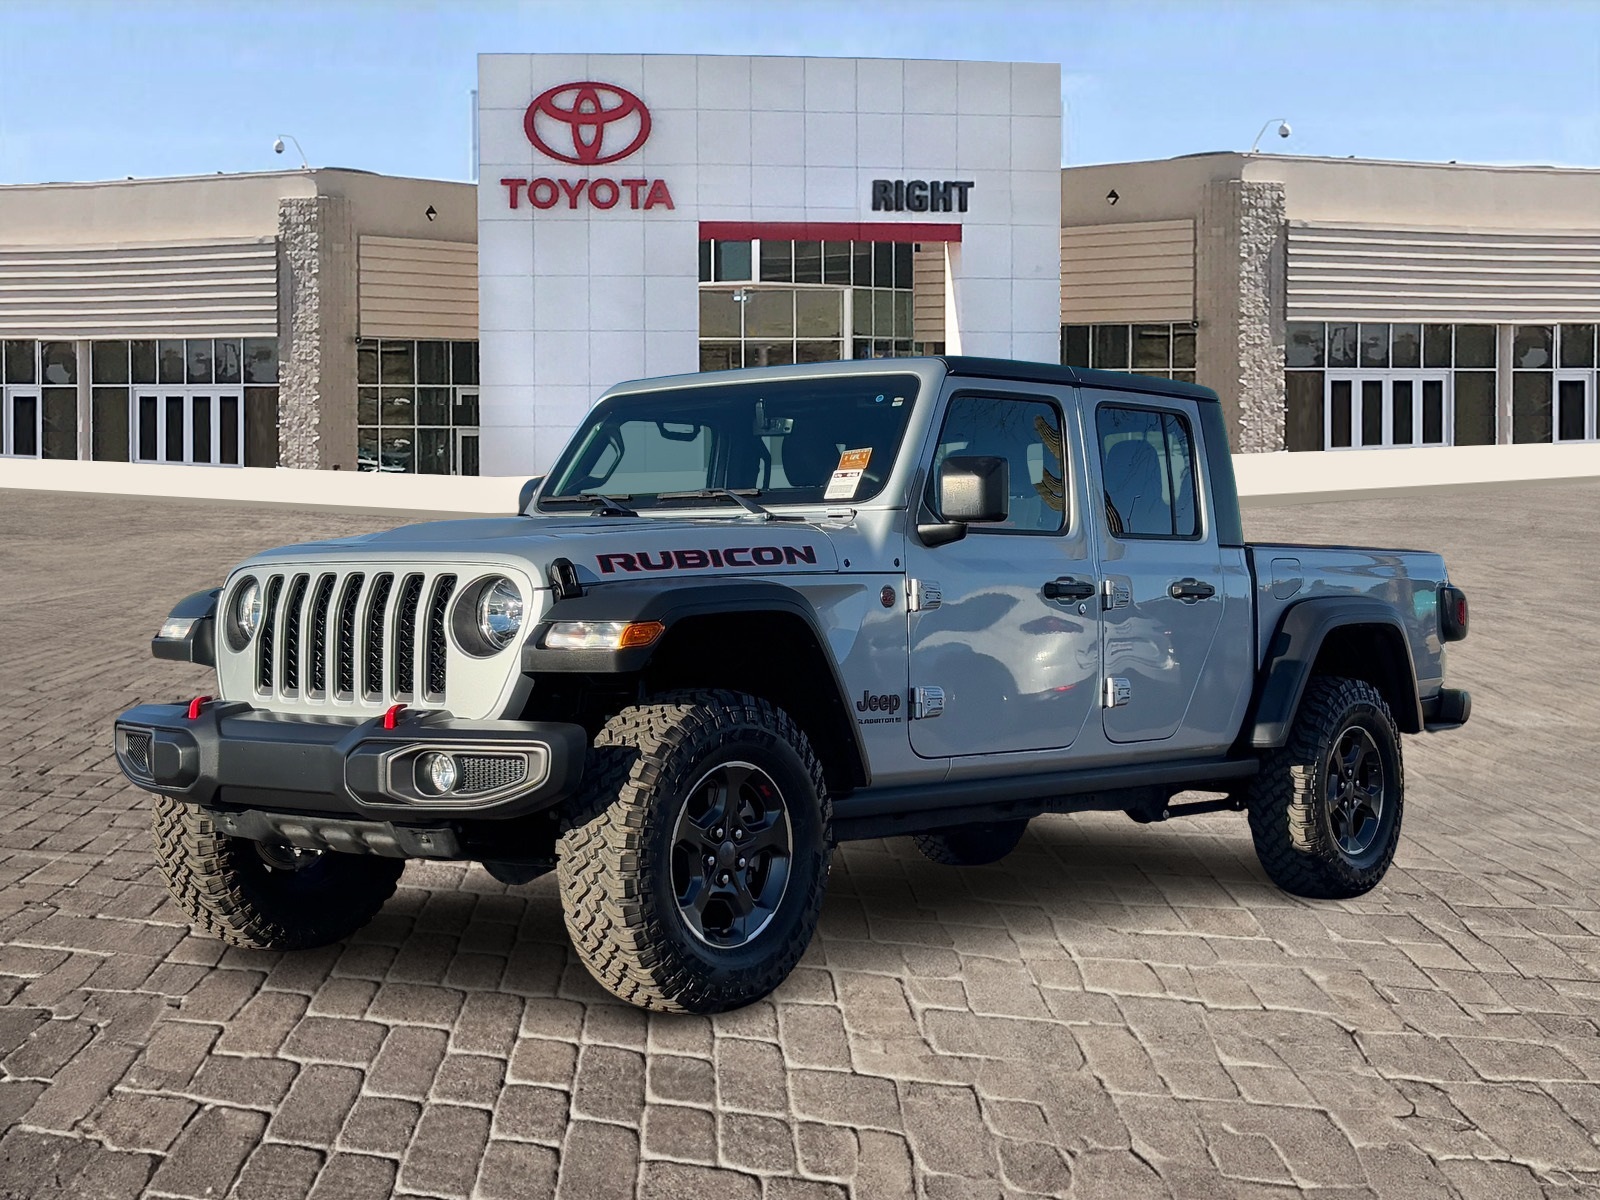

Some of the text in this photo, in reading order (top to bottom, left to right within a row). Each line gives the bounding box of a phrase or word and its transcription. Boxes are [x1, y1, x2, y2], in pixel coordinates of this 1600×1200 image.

[500, 177, 675, 210] TOYOTA
[871, 179, 975, 212] RIGHT
[595, 545, 817, 574] RUBICON
[856, 690, 900, 714] Jeep
